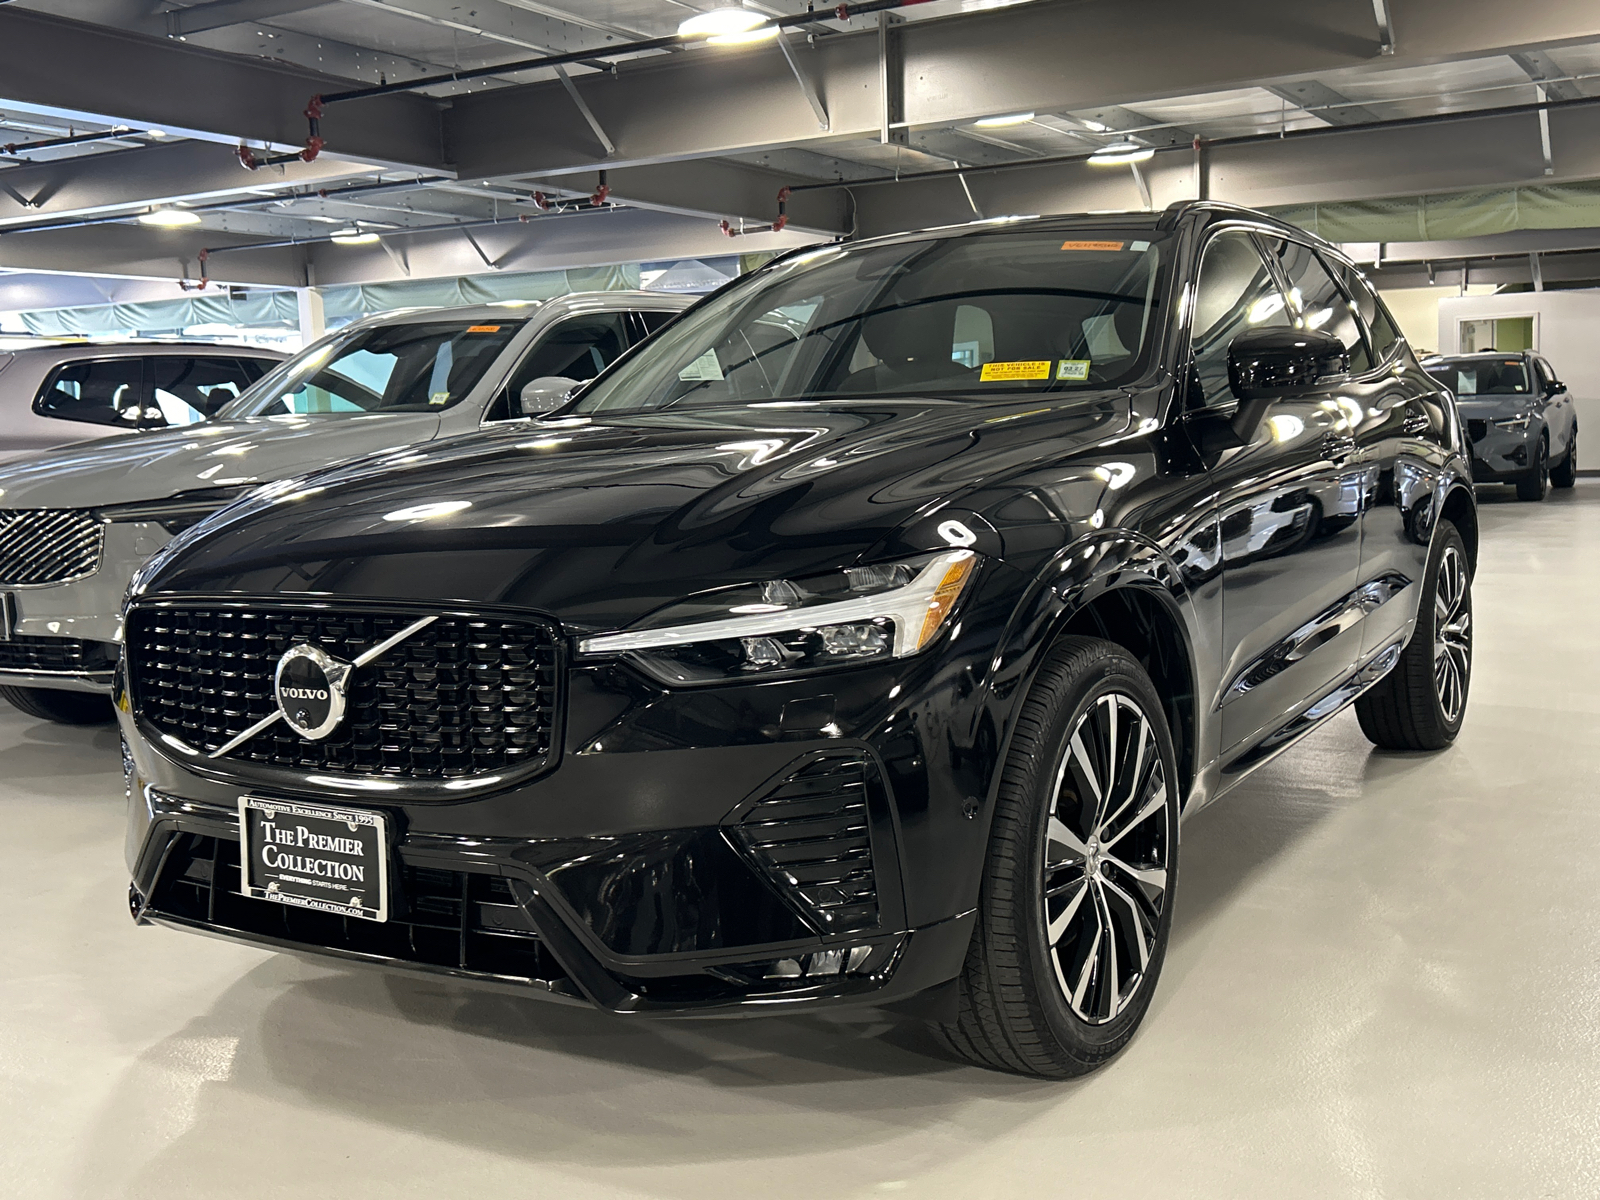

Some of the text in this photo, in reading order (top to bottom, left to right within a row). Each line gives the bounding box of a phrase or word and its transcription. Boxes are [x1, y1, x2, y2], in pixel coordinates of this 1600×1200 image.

[280, 686, 328, 700] VOLVO
[250, 800, 374, 825] AUTOMOTIVE EXCELLENCE SINCE 1995
[260, 821, 364, 856] THE PREMIER
[262, 844, 364, 882] COLLECTION
[278, 873, 349, 891] EVERYTHING STARTS HERE.
